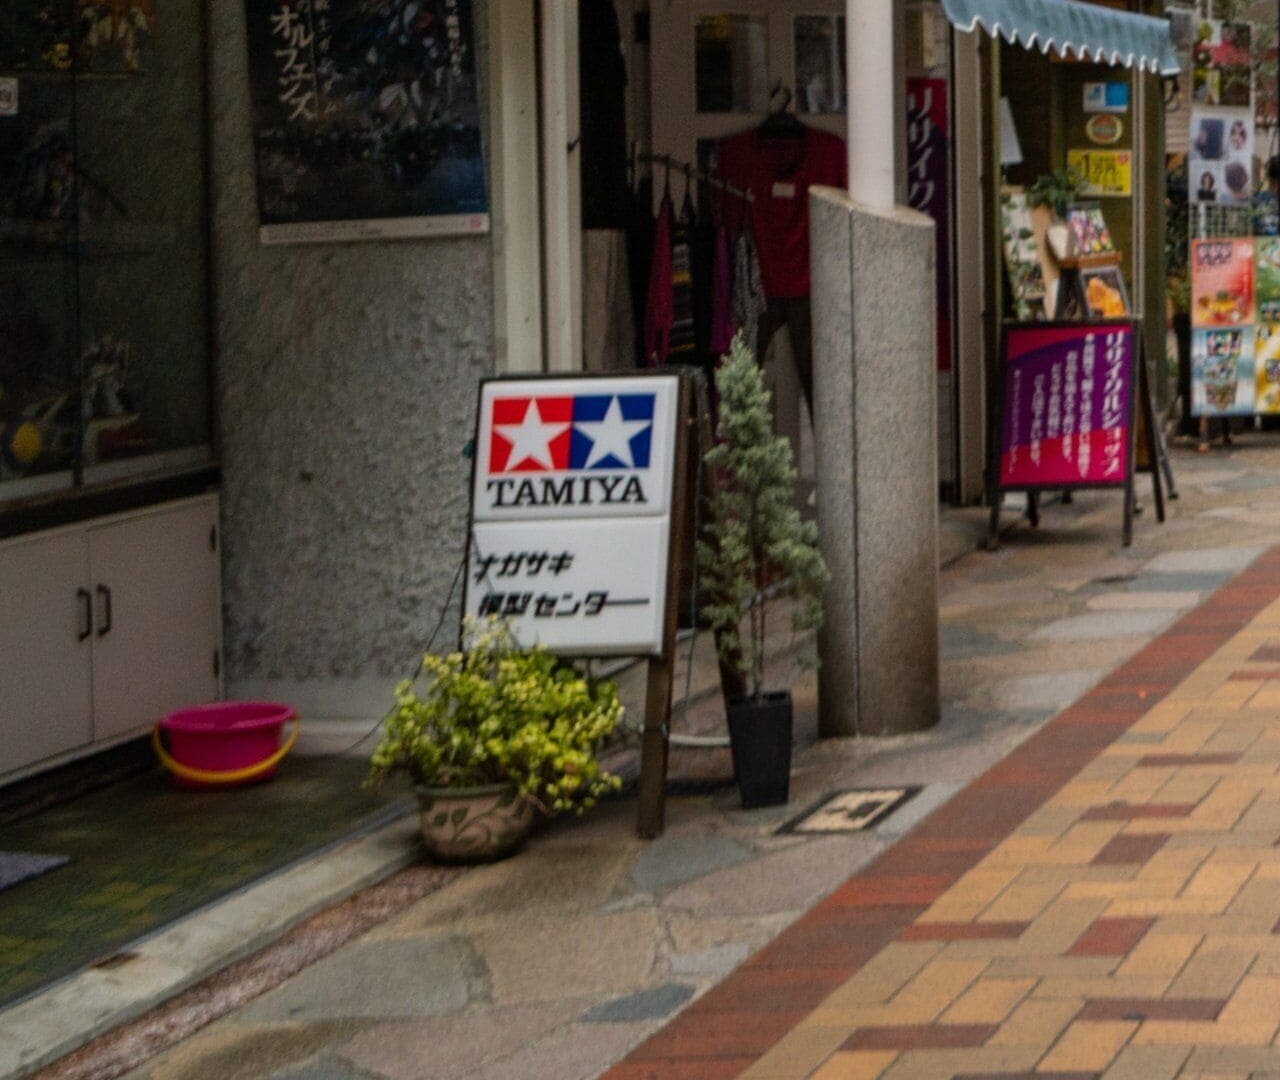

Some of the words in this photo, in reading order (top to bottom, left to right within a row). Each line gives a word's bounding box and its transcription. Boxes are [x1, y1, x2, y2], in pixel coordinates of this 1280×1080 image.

[486, 474, 648, 508] TAMIYA
[473, 550, 574, 586] ナガサキ
